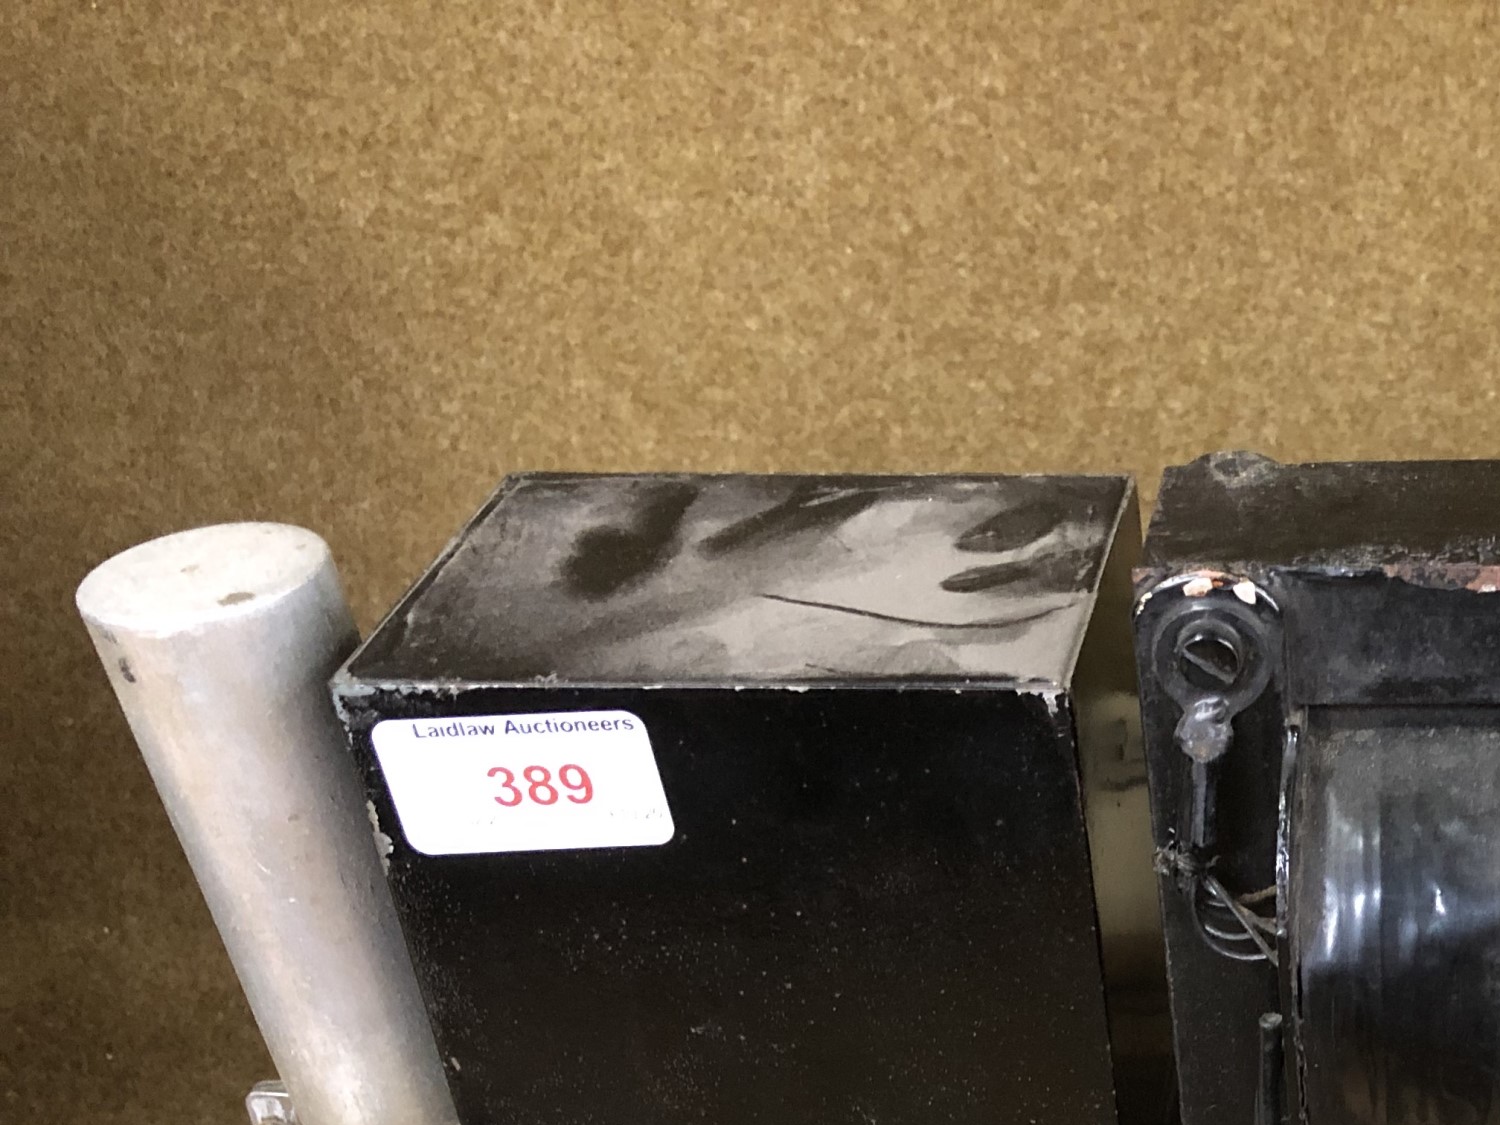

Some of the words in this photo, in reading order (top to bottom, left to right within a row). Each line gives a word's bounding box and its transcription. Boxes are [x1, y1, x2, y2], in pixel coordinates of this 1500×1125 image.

[412, 721, 495, 738] Laidlaw
[504, 717, 635, 735] Auctioneers
[487, 763, 594, 807] 389
